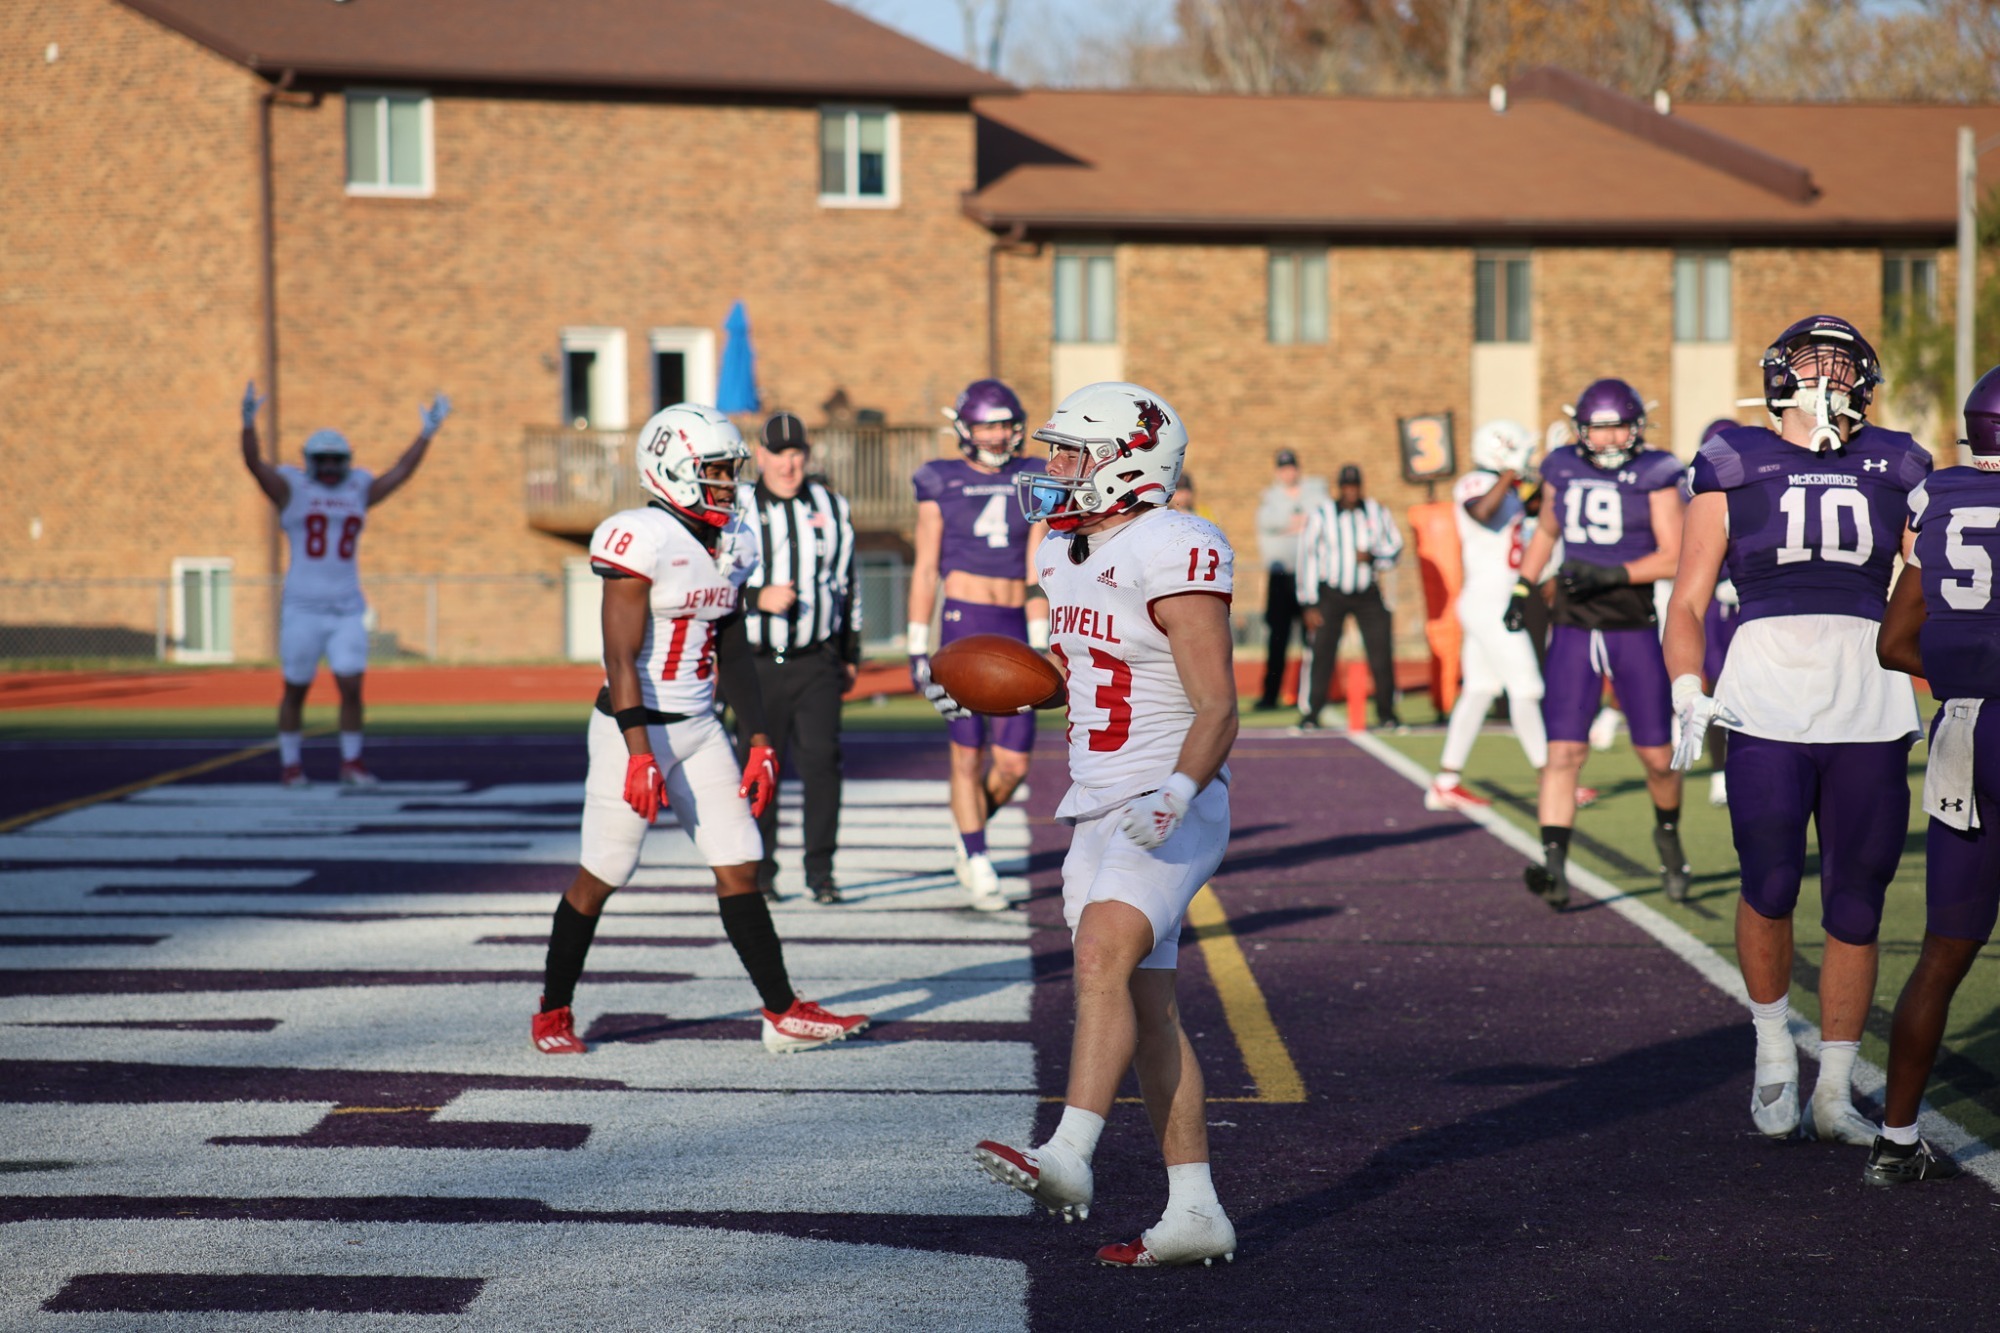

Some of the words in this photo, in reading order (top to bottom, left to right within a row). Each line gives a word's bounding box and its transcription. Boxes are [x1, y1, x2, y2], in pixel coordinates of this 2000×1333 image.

[648, 426, 672, 457] 18
[1408, 419, 1447, 475] 3
[1788, 474, 1858, 487] McKENDREE
[305, 513, 363, 560] 88
[974, 495, 1010, 548] 4
[1563, 486, 1623, 545] 19
[1776, 487, 1874, 566] 10
[604, 527, 634, 556] 18
[1187, 547, 1220, 581] 13
[1940, 506, 2000, 610] 5
[1097, 575, 1118, 588] adidas
